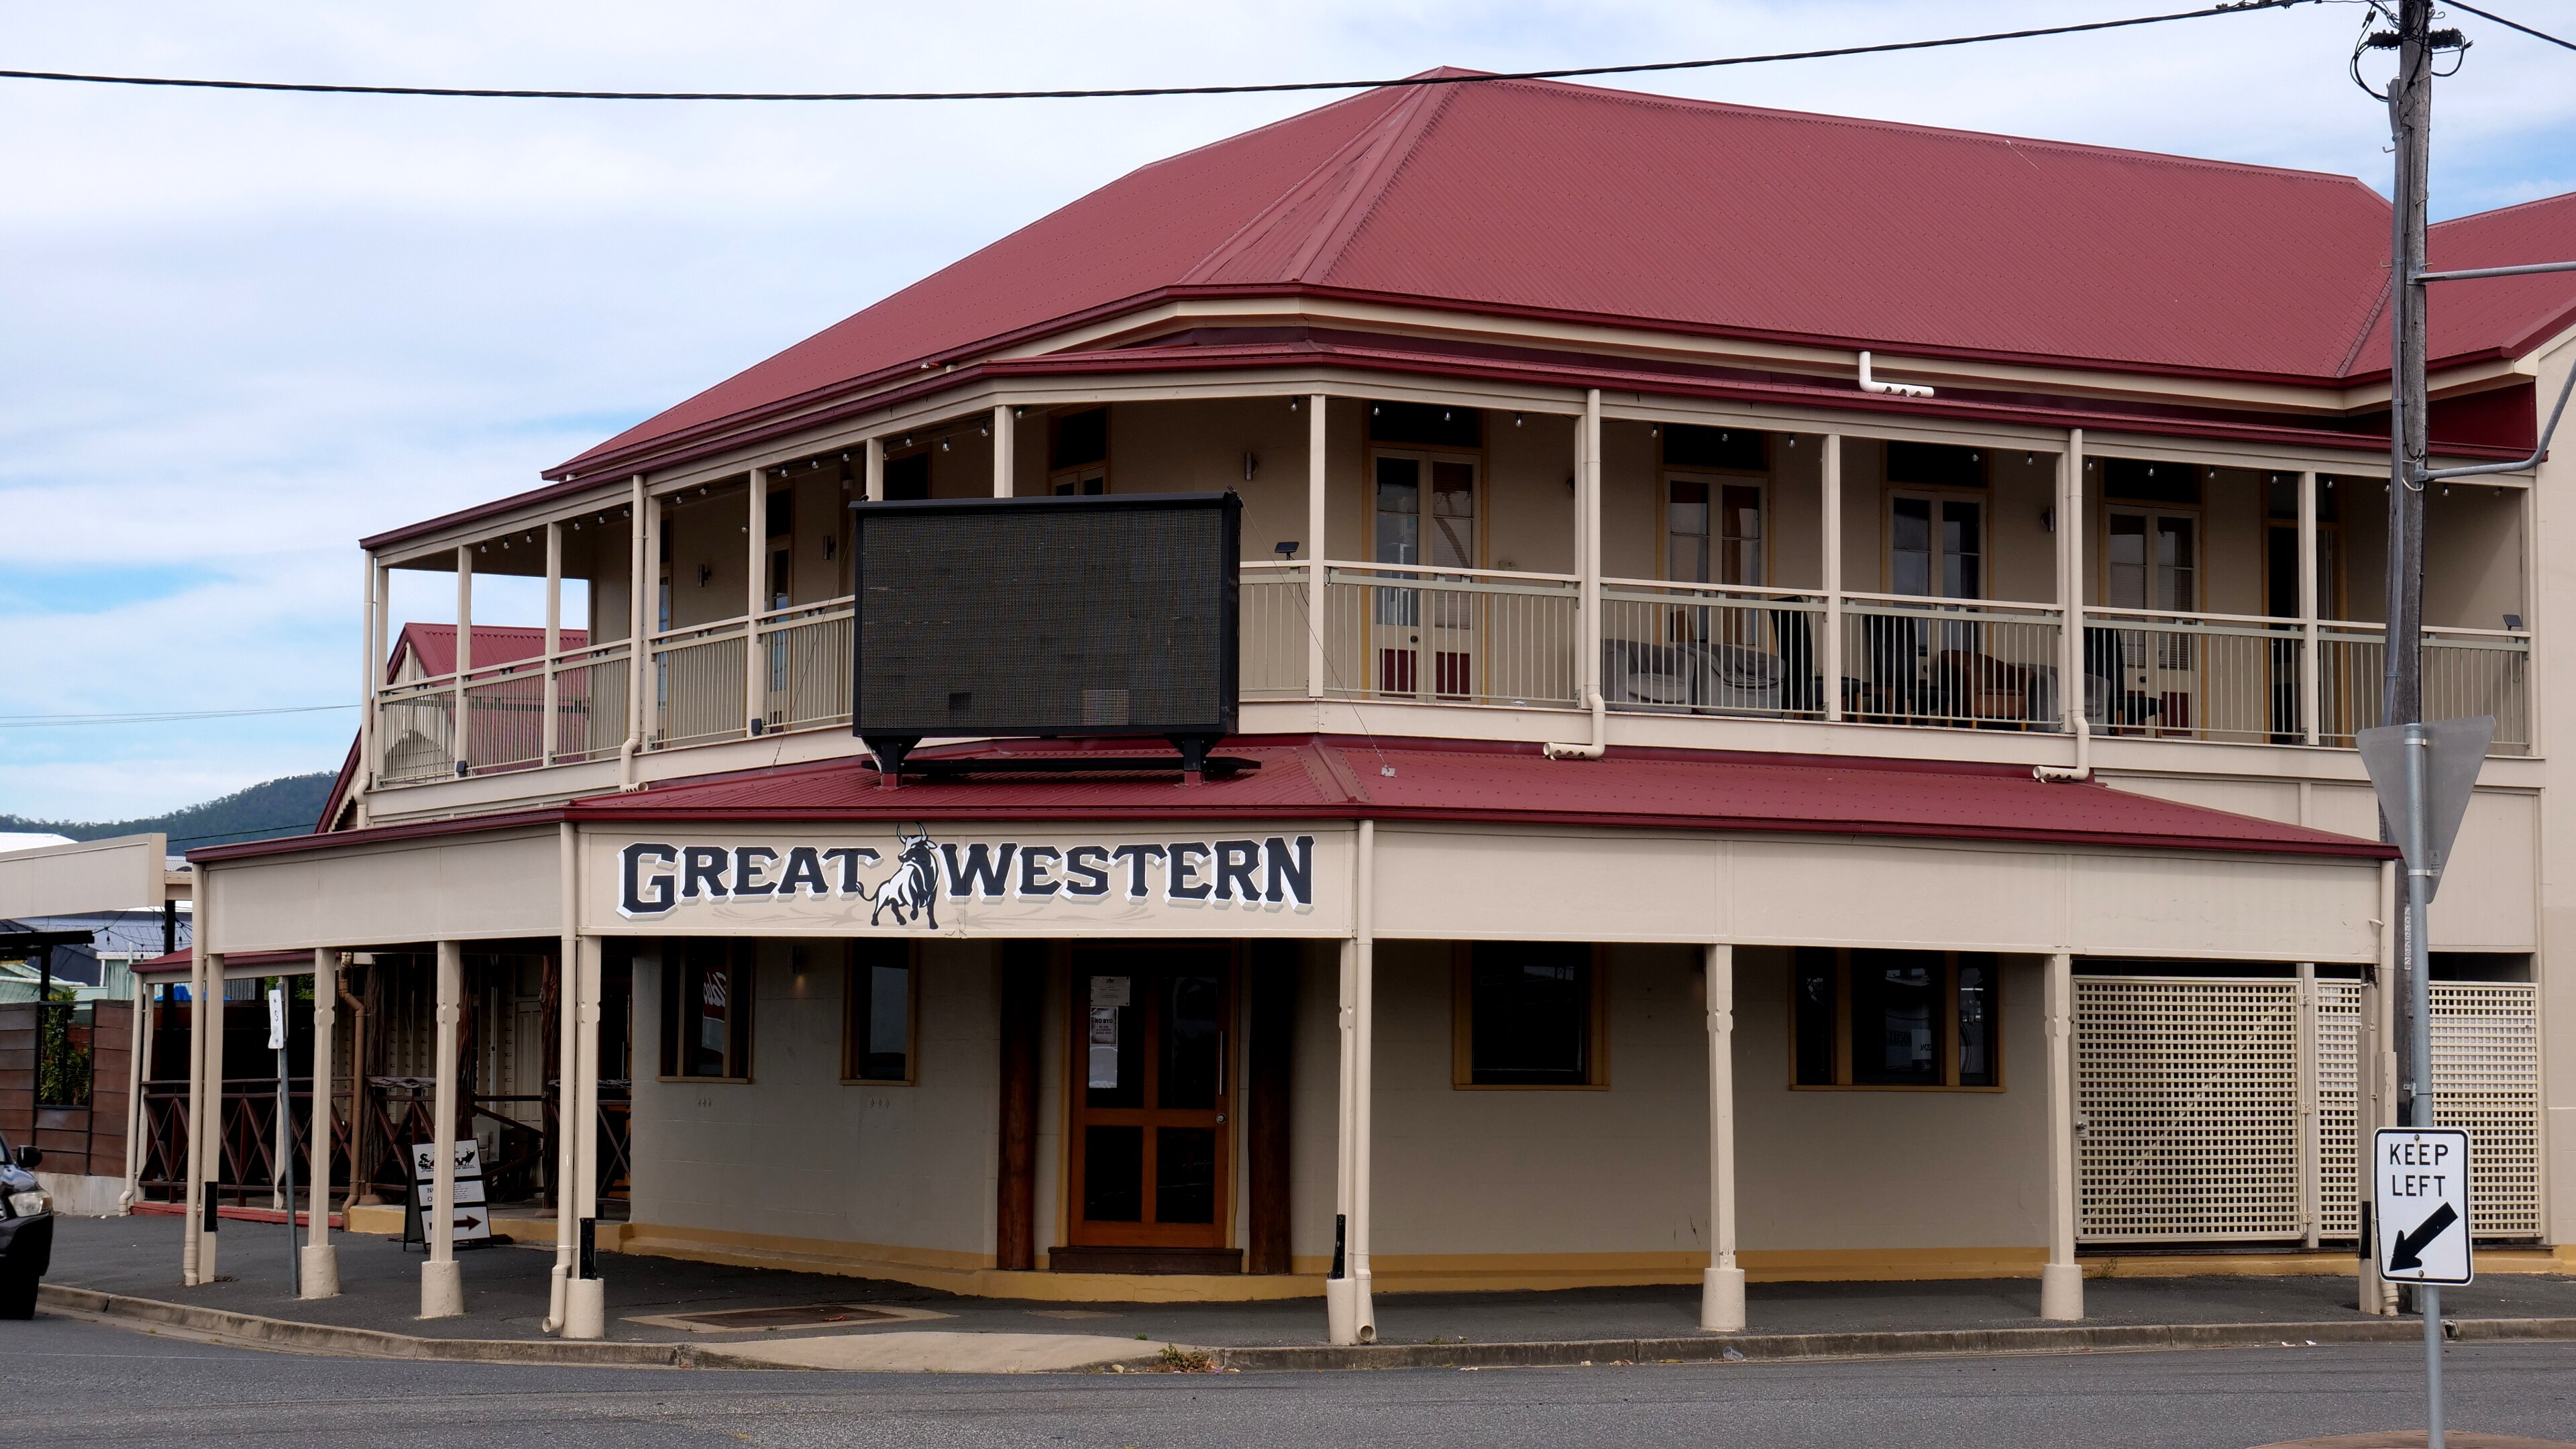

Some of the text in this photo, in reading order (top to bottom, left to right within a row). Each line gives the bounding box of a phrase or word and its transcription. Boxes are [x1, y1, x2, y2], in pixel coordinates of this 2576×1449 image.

[618, 835, 1316, 919] GREAT WESTERN
[2390, 1143, 2449, 1165] KEEP
[2392, 1175, 2446, 1197] LEFT
